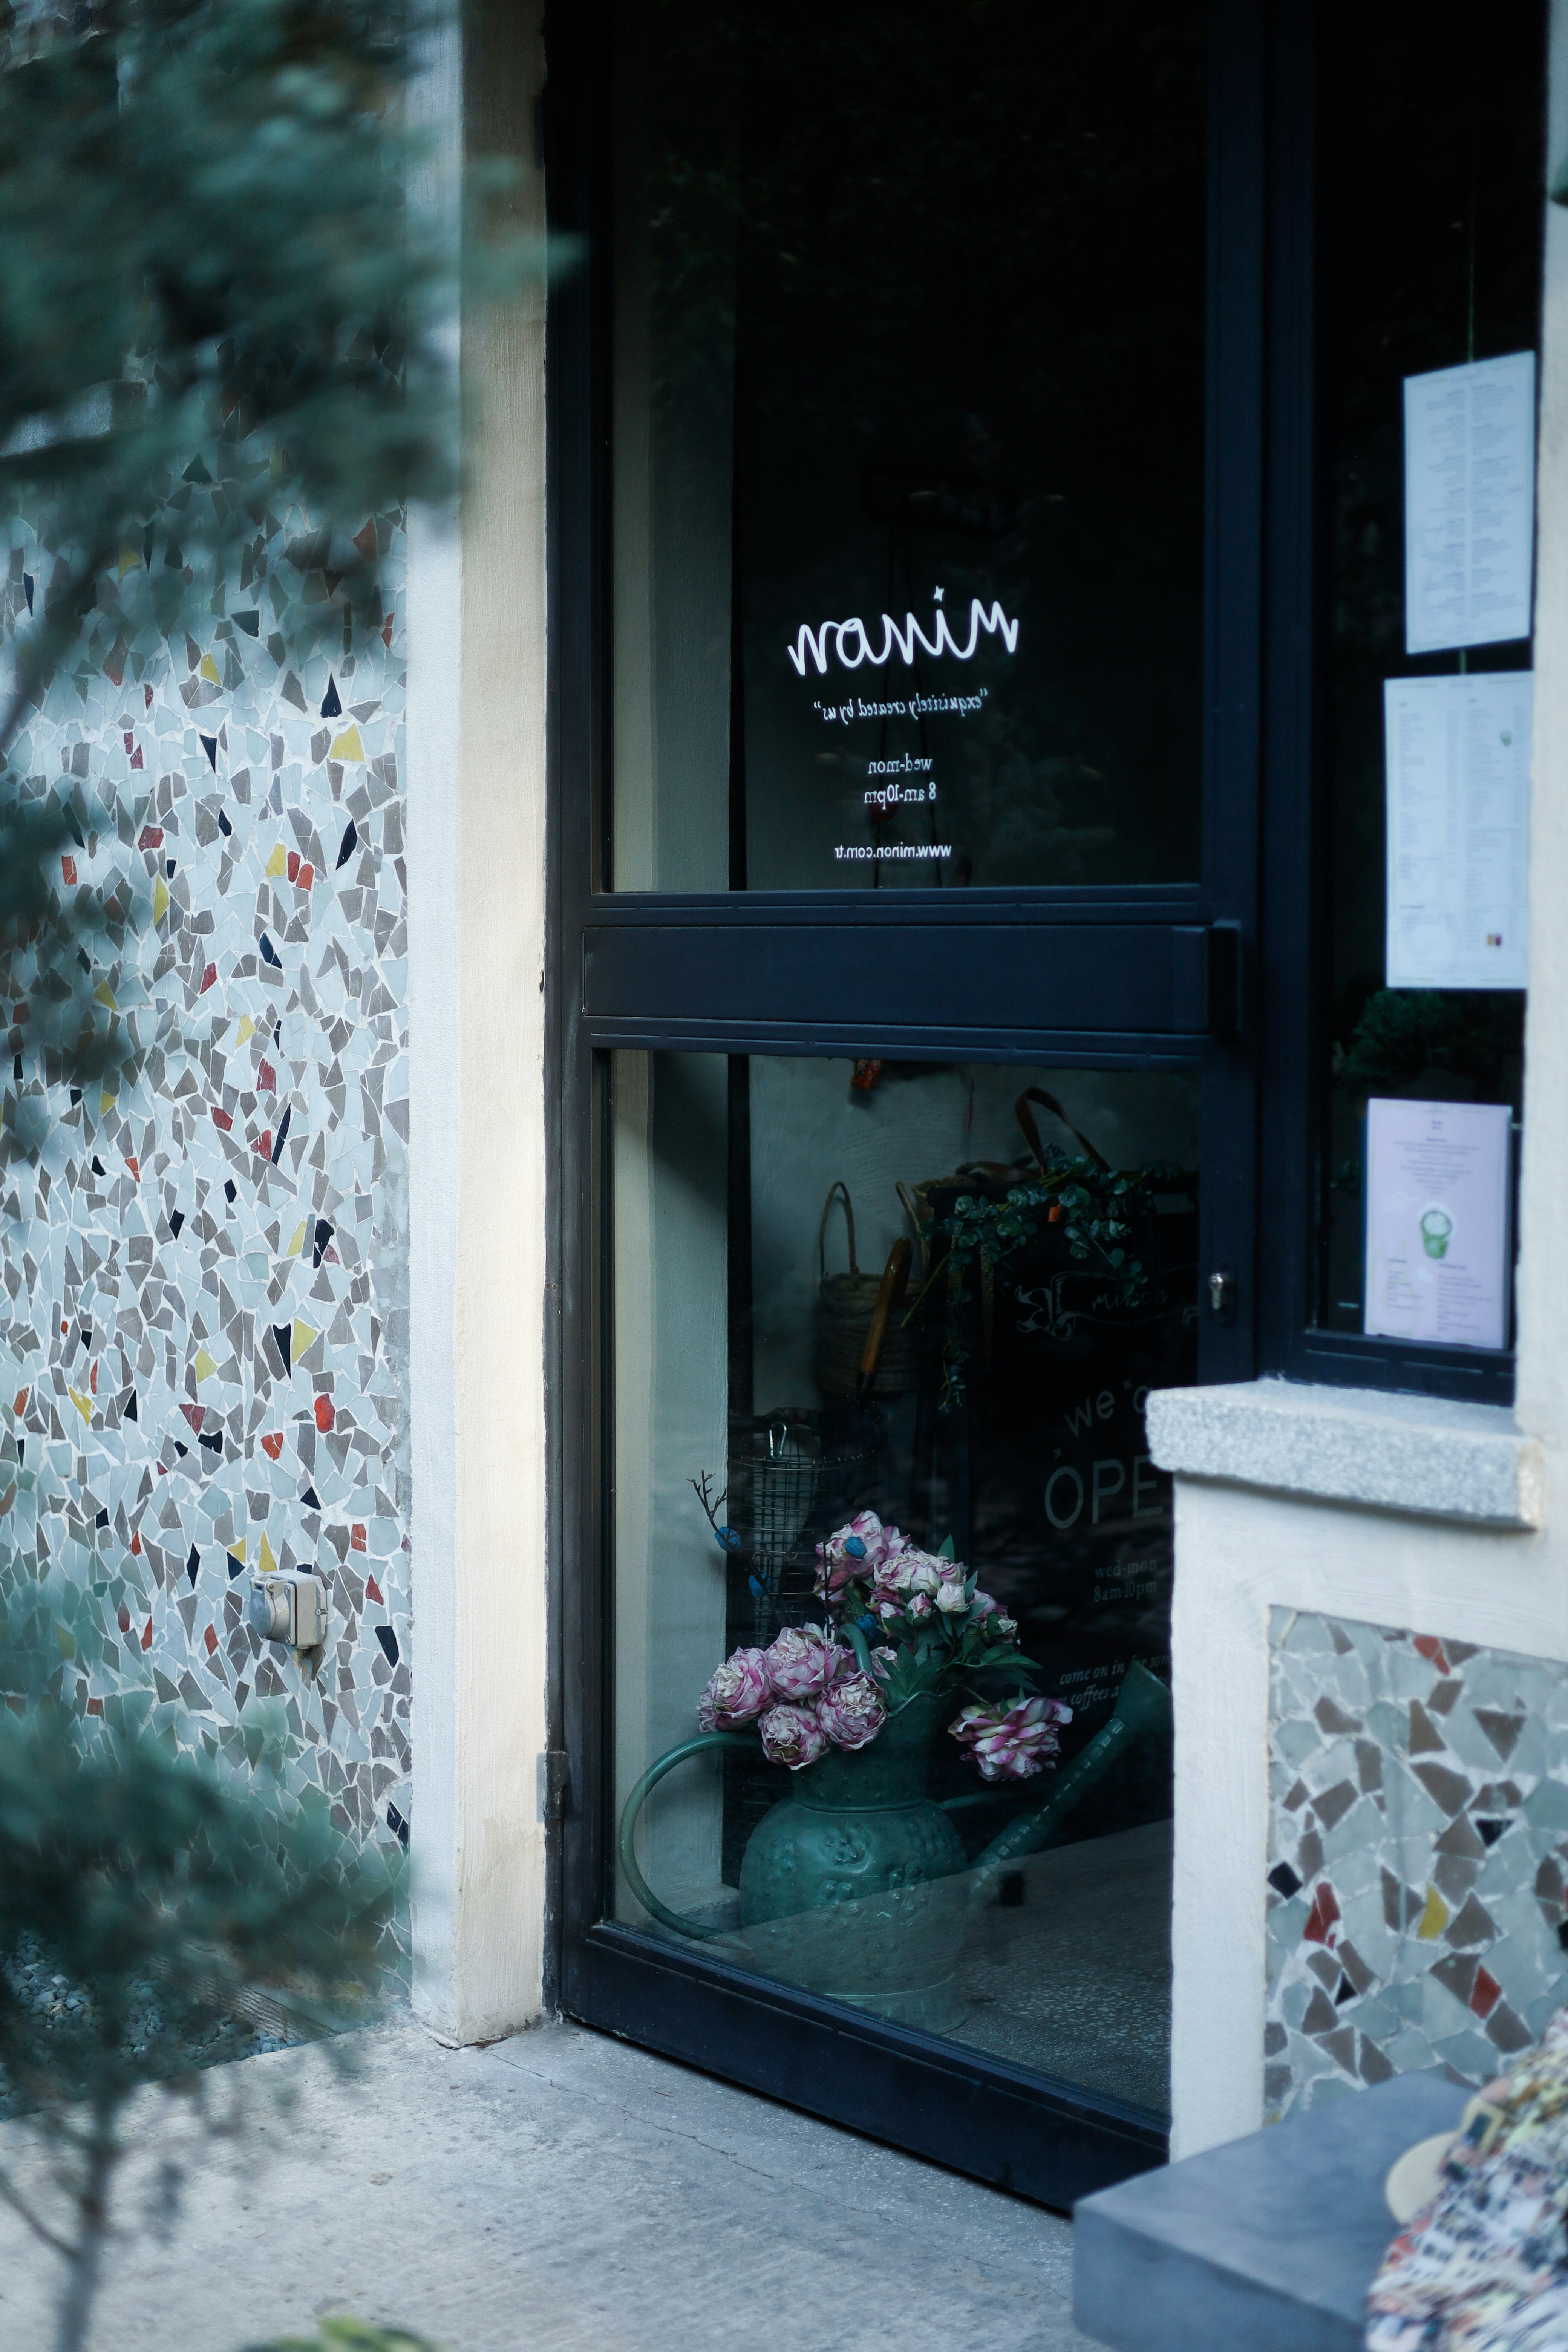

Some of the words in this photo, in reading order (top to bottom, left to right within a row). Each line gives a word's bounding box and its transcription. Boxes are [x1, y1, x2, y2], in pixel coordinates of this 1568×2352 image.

[1044, 1455, 1164, 1530] OPE
[1094, 1559, 1158, 1578] wed-mon
[1059, 1668, 1091, 1685] come
[1093, 1664, 1109, 1679] on
[1111, 1659, 1125, 1675] in
[1070, 1683, 1110, 1711] coffees
